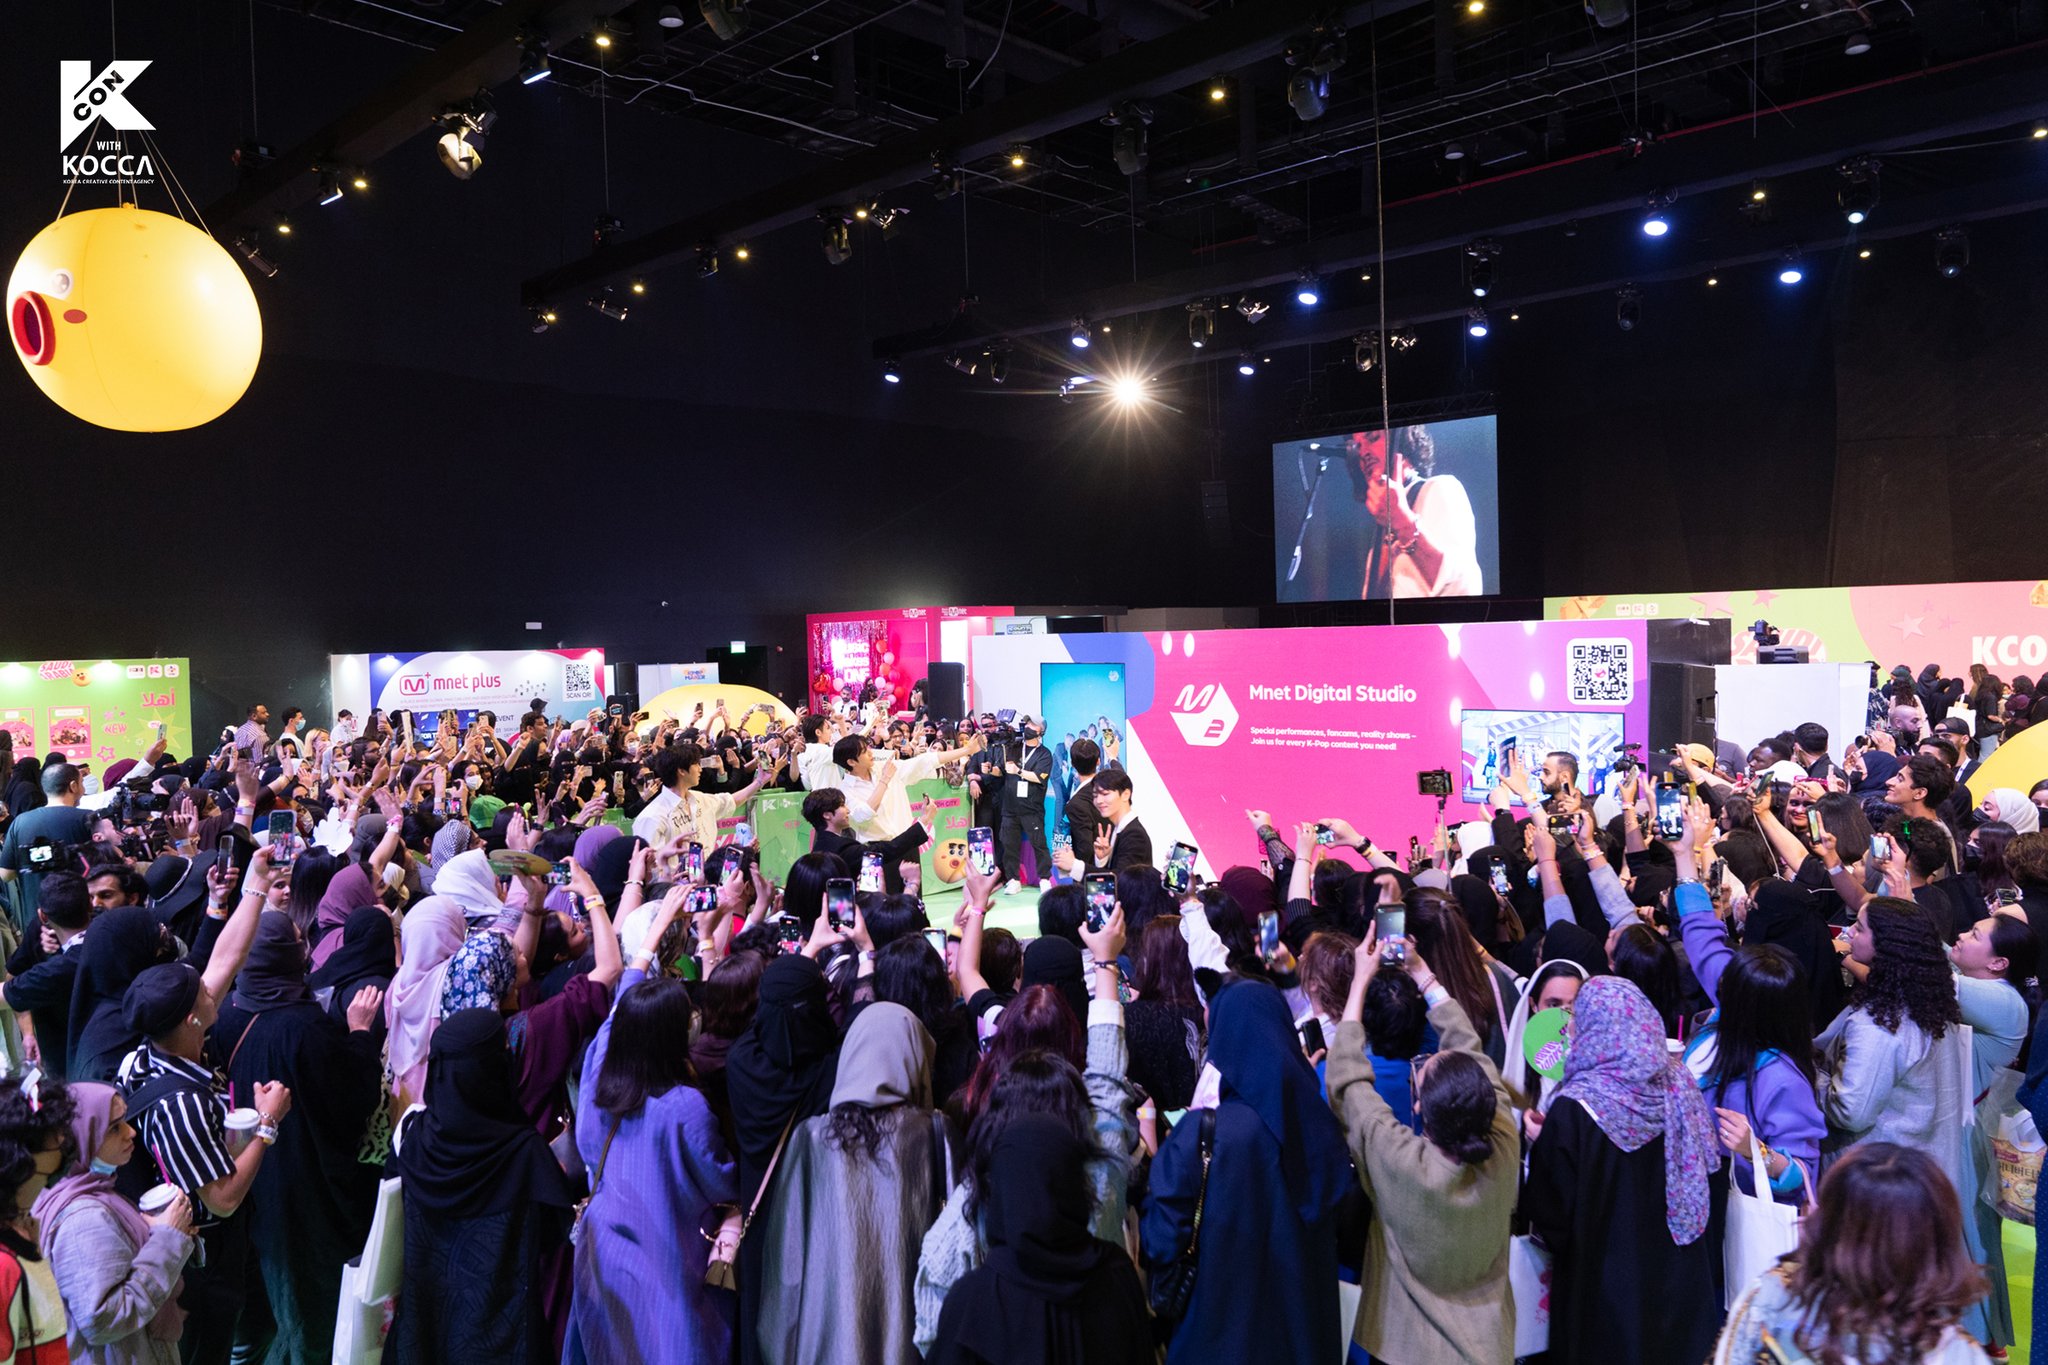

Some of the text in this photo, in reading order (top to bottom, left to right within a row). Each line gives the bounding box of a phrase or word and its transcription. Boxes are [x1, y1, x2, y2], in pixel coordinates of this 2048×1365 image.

[1972, 635, 2047, 666] KCO
[433, 673, 469, 690] mnet
[473, 672, 501, 692] plus
[1249, 683, 1417, 704] Mnet Digital Studio
[1250, 726, 1275, 735] Special
[1276, 728, 1326, 737] performances,
[1327, 729, 1360, 738] fancams,
[1361, 730, 1385, 739] reality
[1386, 731, 1410, 739] shows
[1275, 738, 1285, 746] for
[1286, 740, 1305, 748] every
[1306, 740, 1330, 749] K-Pop
